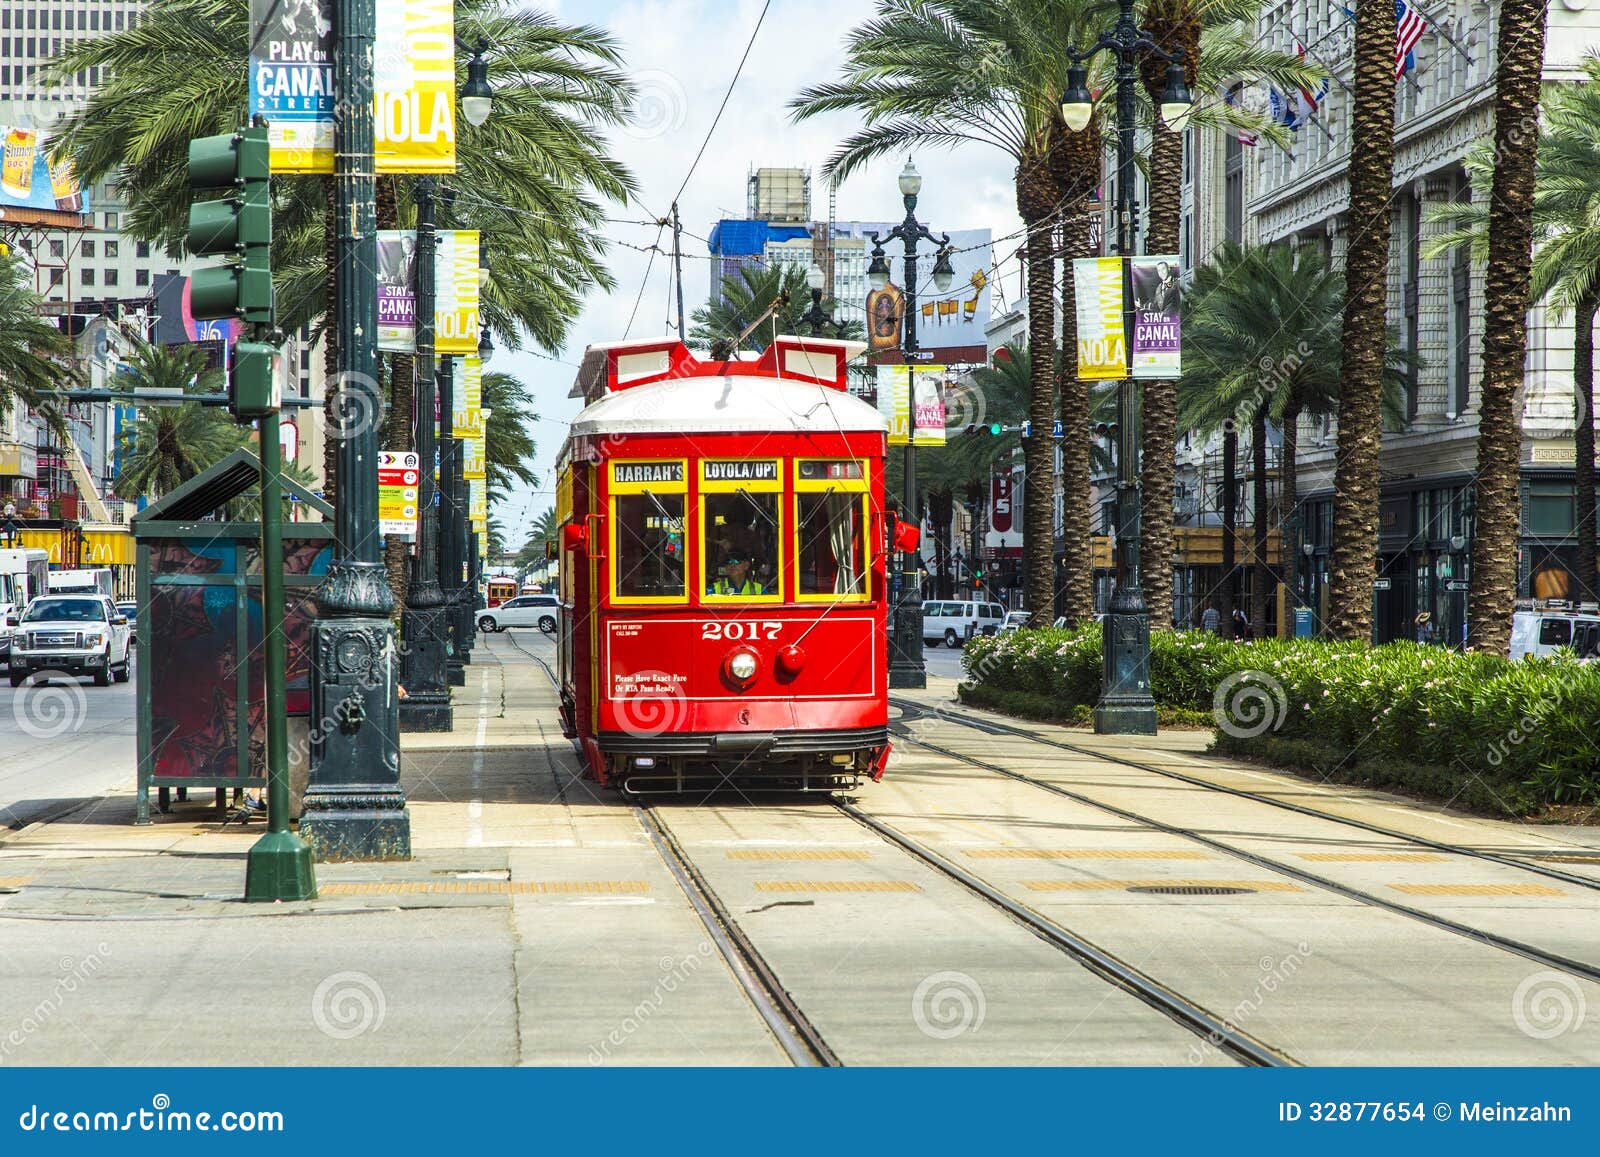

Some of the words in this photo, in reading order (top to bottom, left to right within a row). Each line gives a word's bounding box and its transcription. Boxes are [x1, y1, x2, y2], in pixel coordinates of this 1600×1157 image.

[269, 40, 313, 61] PLAY
[313, 50, 327, 61] ON
[257, 67, 334, 97] CANAL
[258, 98, 325, 109] STREE
[454, 242, 478, 311] TOWN
[385, 286, 407, 297] STAY
[1097, 270, 1124, 337] TOWN
[1143, 312, 1163, 323] STAY
[1137, 325, 1178, 341] CANAL
[1079, 338, 1126, 367] NOLA
[615, 463, 683, 482] HARRAH'S
[702, 622, 783, 641] 2017
[615, 674, 633, 682] Please
[635, 674, 650, 682] Have
[652, 674, 671, 682] Exact
[673, 673, 687, 682] Fare
[615, 684, 624, 692] Or
[655, 684, 675, 693] Ready
